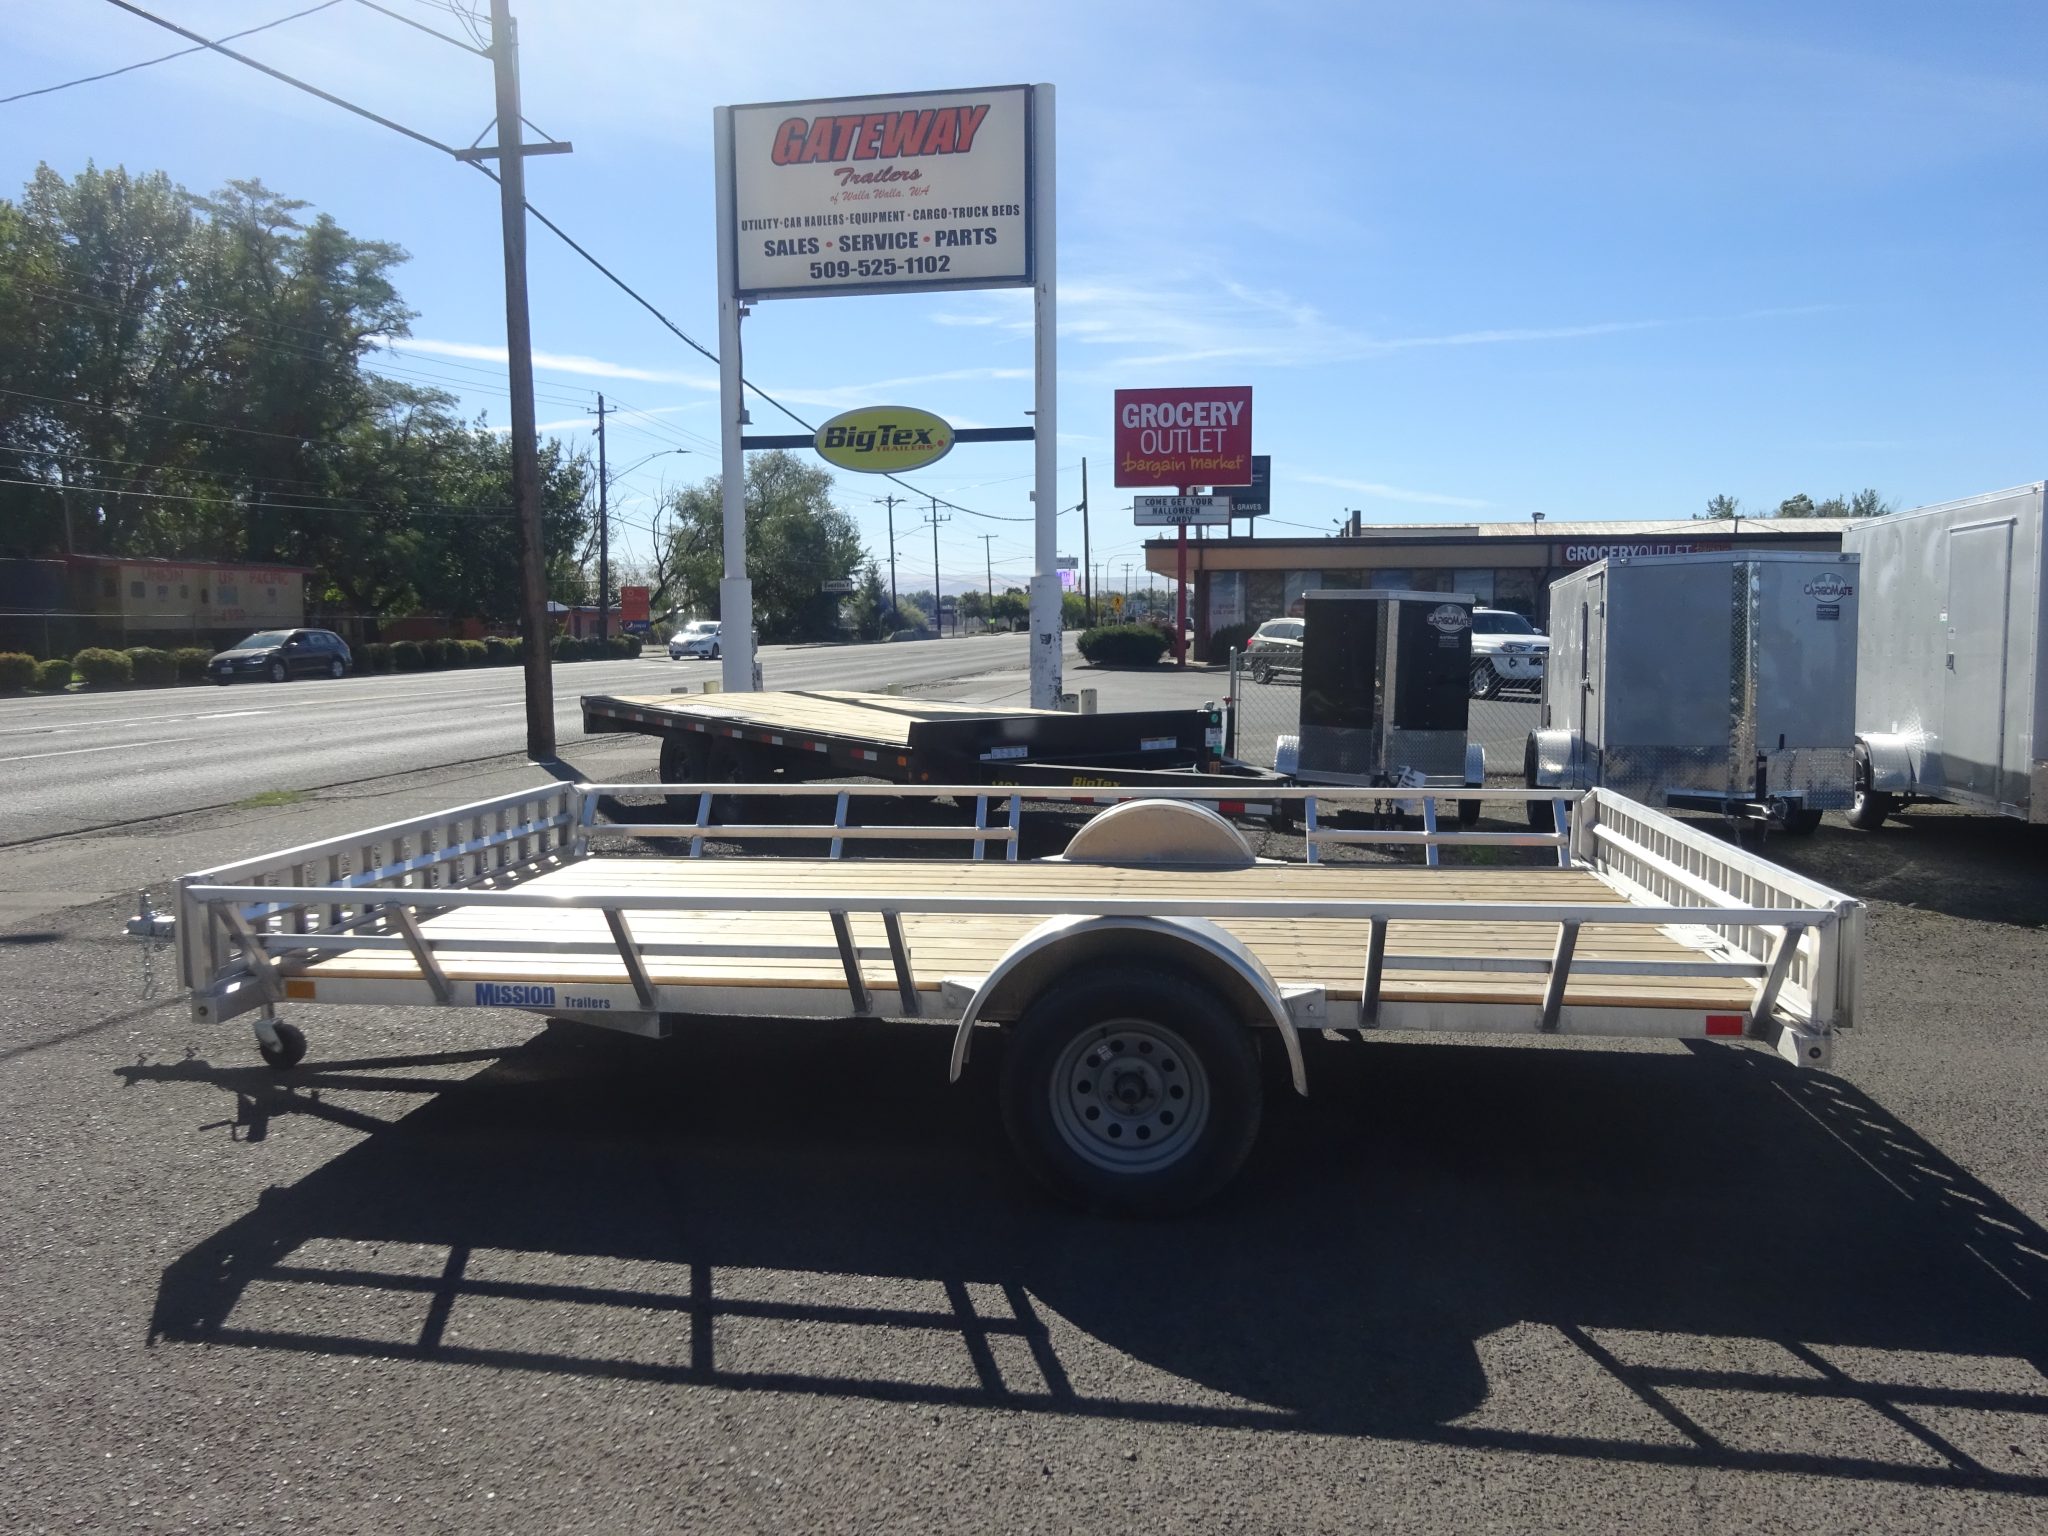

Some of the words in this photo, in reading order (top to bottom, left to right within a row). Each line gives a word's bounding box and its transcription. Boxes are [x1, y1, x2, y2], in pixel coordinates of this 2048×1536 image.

[771, 104, 990, 166] GATEWAY
[833, 165, 922, 187] Trailers
[830, 192, 840, 205] of
[842, 190, 870, 201] Walla
[908, 184, 930, 197] WA
[991, 204, 1020, 217] BEDS
[763, 237, 820, 257] SALES
[838, 231, 919, 252] SERVICE
[935, 227, 998, 247] PARTS
[810, 255, 950, 279] 509-525-1102
[1122, 401, 1244, 428] GROCERY
[824, 424, 936, 452] BigTex
[875, 444, 934, 453] TRAILERS
[1140, 428, 1227, 455] OUTLET
[1121, 452, 1186, 479] bargain
[1190, 454, 1245, 470] market
[1145, 497, 1167, 506] COME
[1171, 497, 1187, 506] GET
[1191, 497, 1213, 506] YOUR
[1152, 507, 1200, 515] HALLOWEEN
[1166, 515, 1192, 523] CANDY
[564, 996, 611, 1009] Trailers
